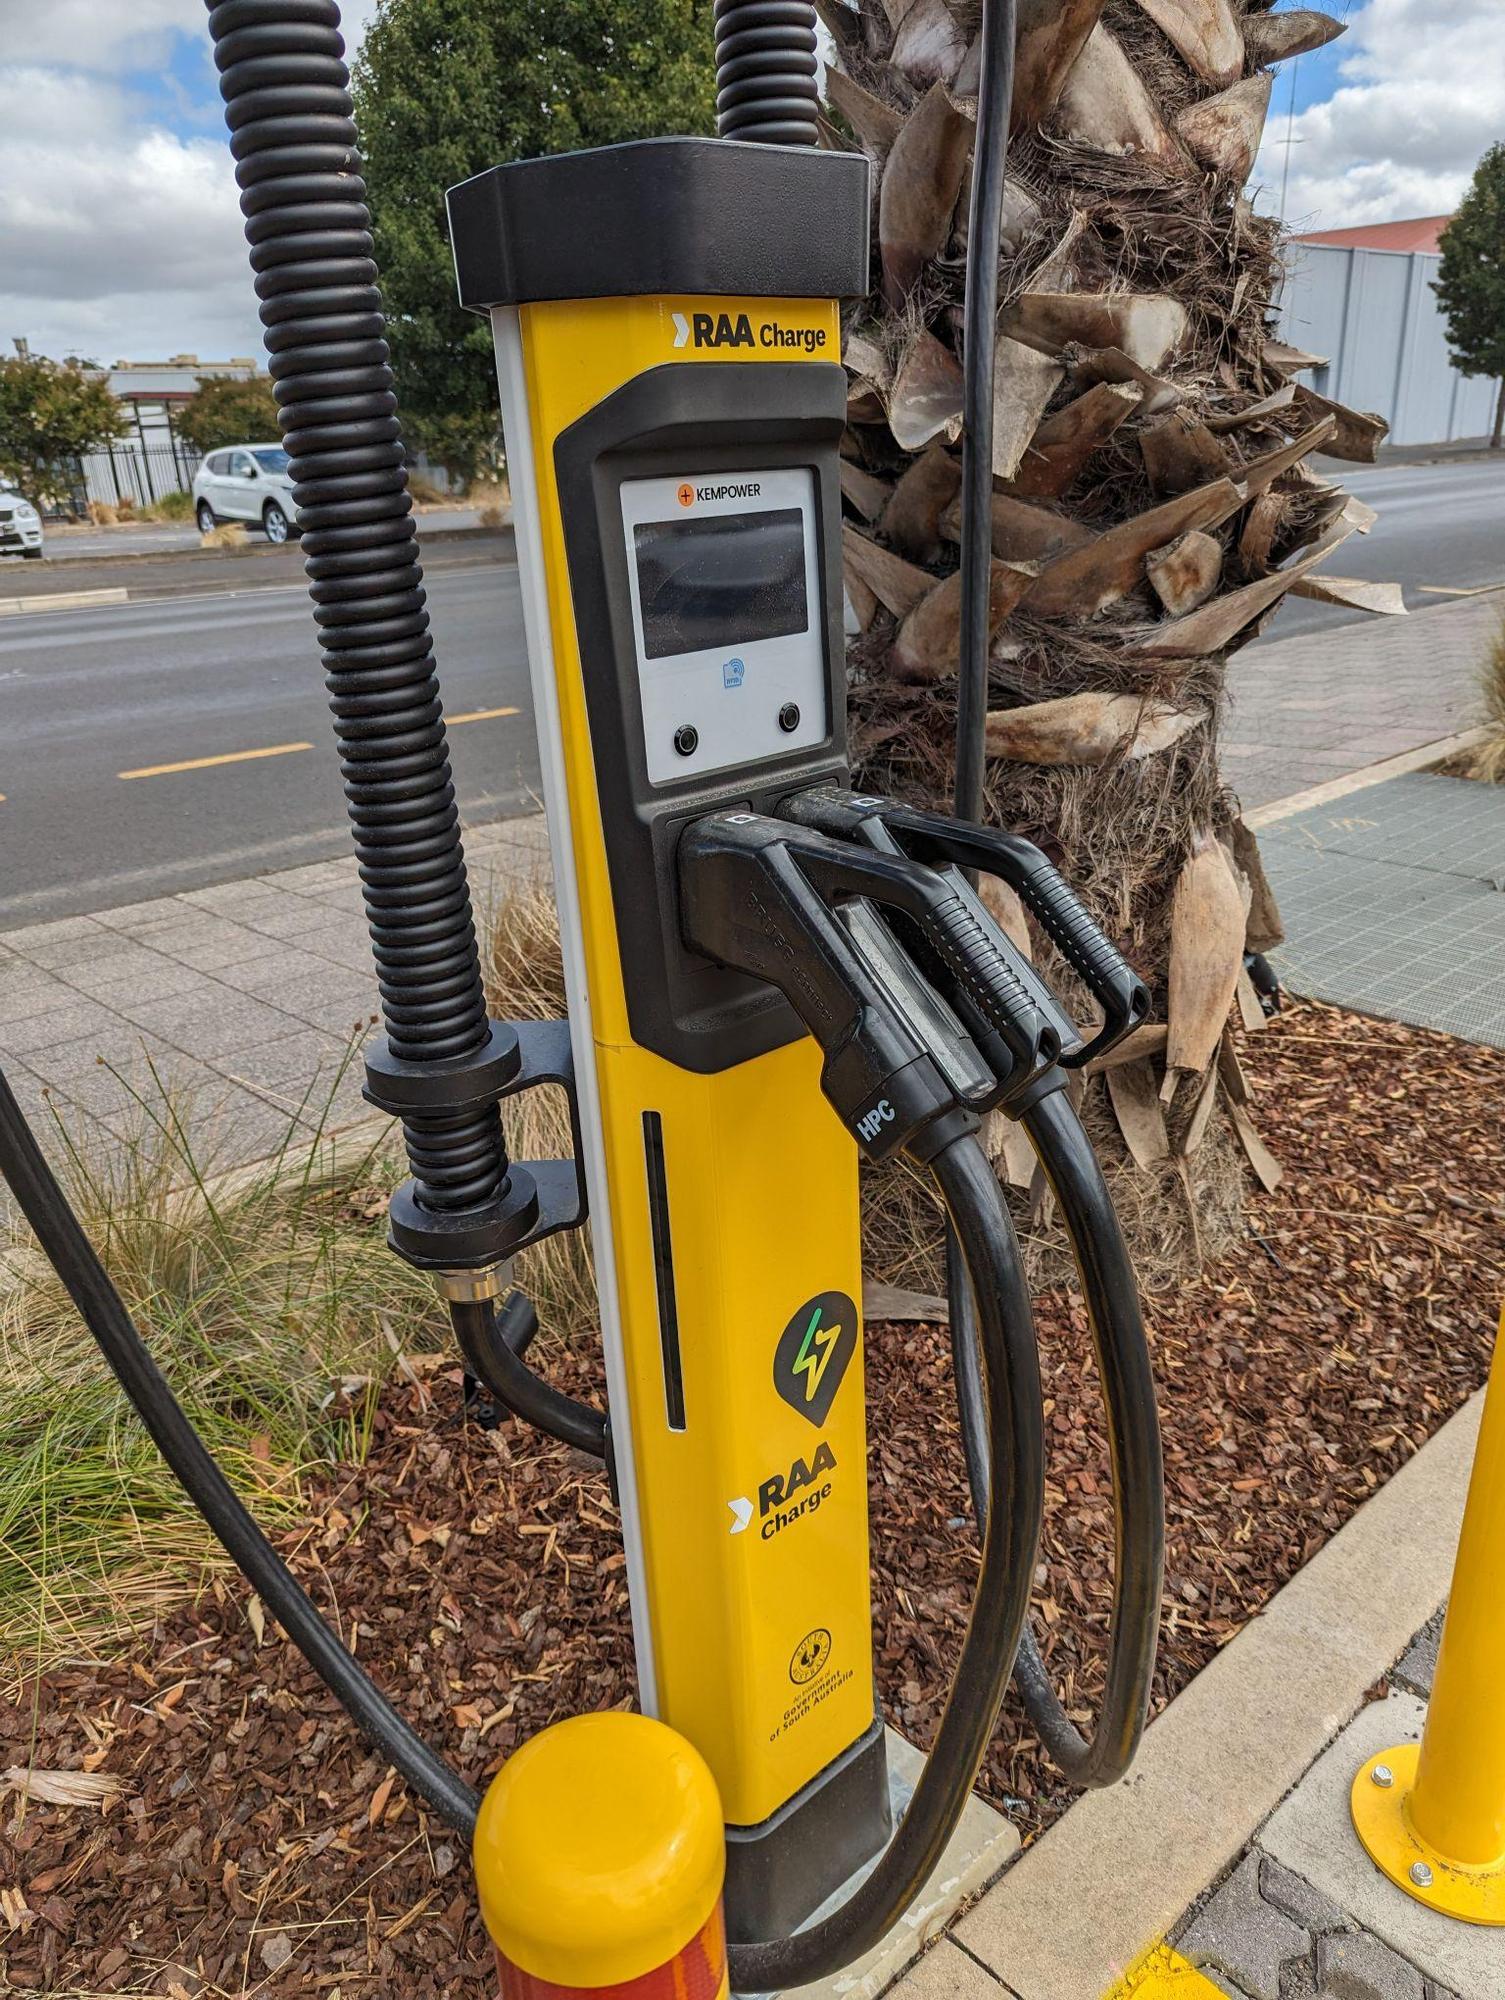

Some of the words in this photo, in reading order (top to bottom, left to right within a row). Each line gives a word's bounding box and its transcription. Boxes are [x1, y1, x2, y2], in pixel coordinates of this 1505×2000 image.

[693, 314, 755, 347] RAA
[760, 323, 826, 353] Charge
[696, 483, 761, 501] KEMPOWER
[856, 1100, 895, 1142] HPC
[759, 1441, 837, 1518] RAA
[761, 1483, 832, 1540] Charge
[769, 1728, 780, 1742] of
[783, 1705, 810, 1731] South
[813, 1669, 854, 1706] Australia
[783, 1670, 841, 1721] Government
